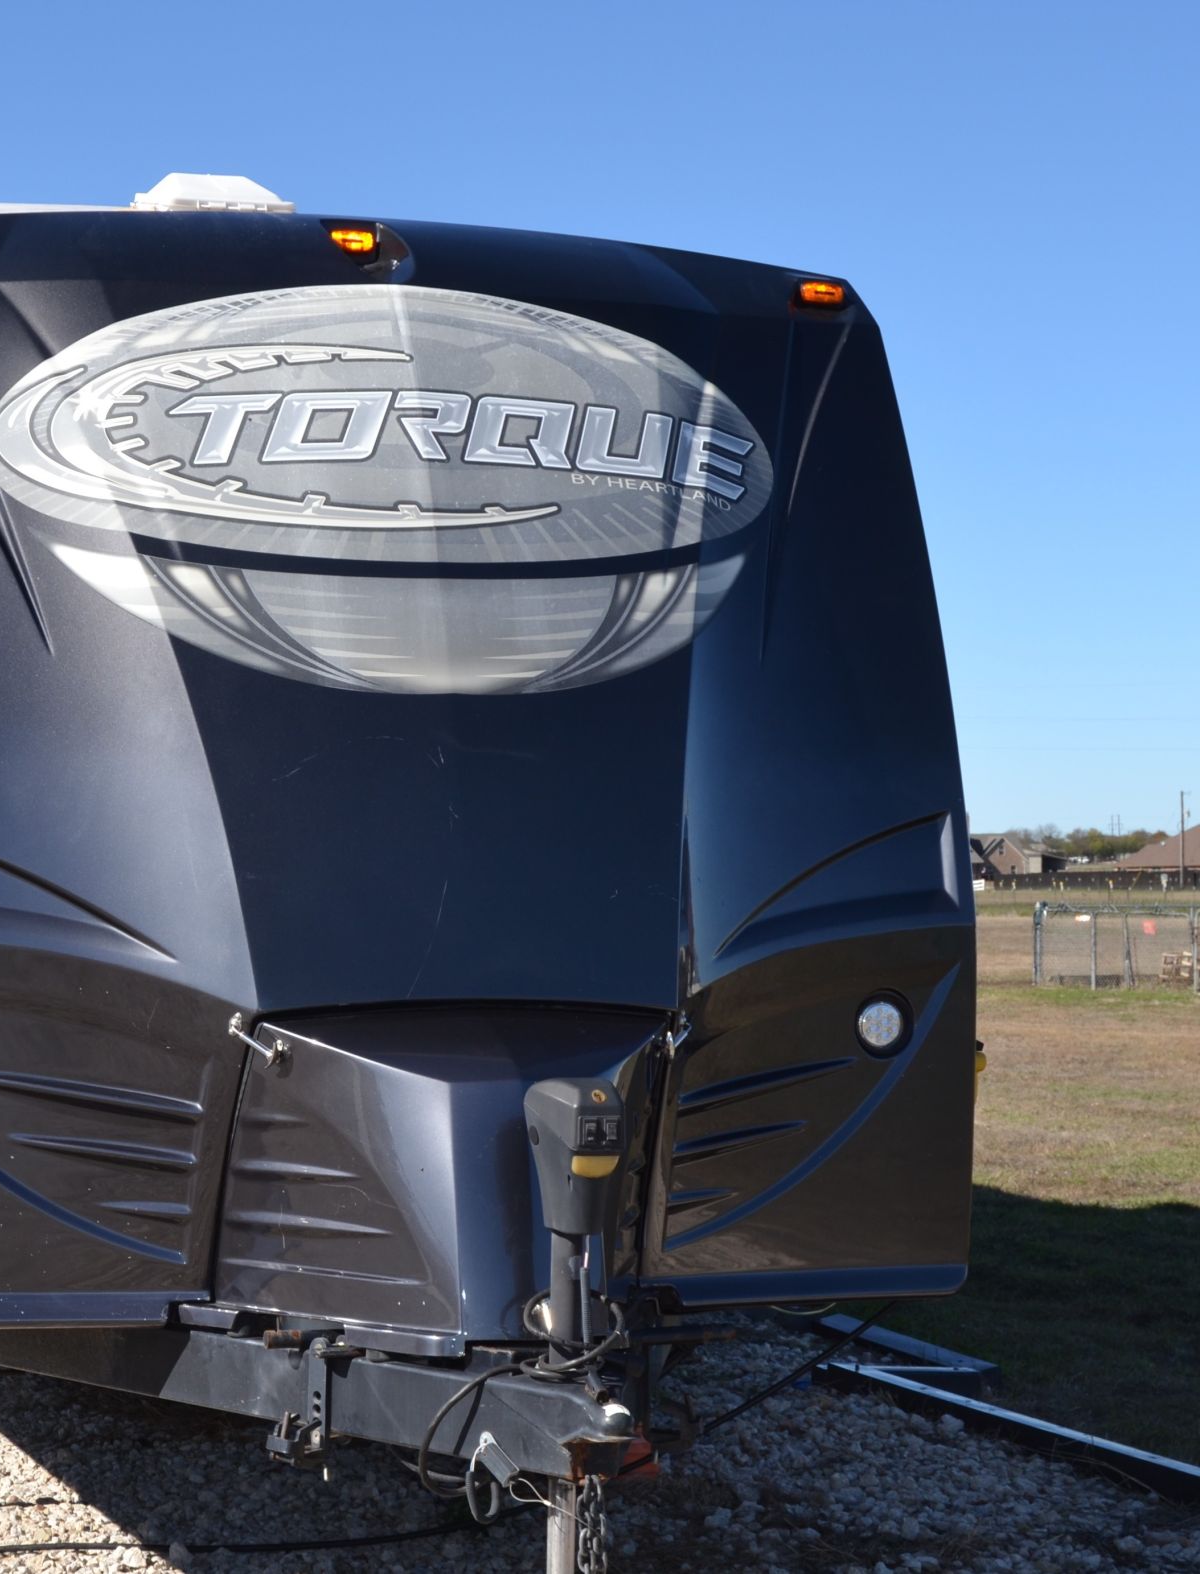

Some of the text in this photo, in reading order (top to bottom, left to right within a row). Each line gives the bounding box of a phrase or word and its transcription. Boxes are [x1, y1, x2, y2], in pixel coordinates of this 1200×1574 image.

[167, 391, 754, 500] TORQUE
[571, 473, 731, 512] BY HEARTLAND
